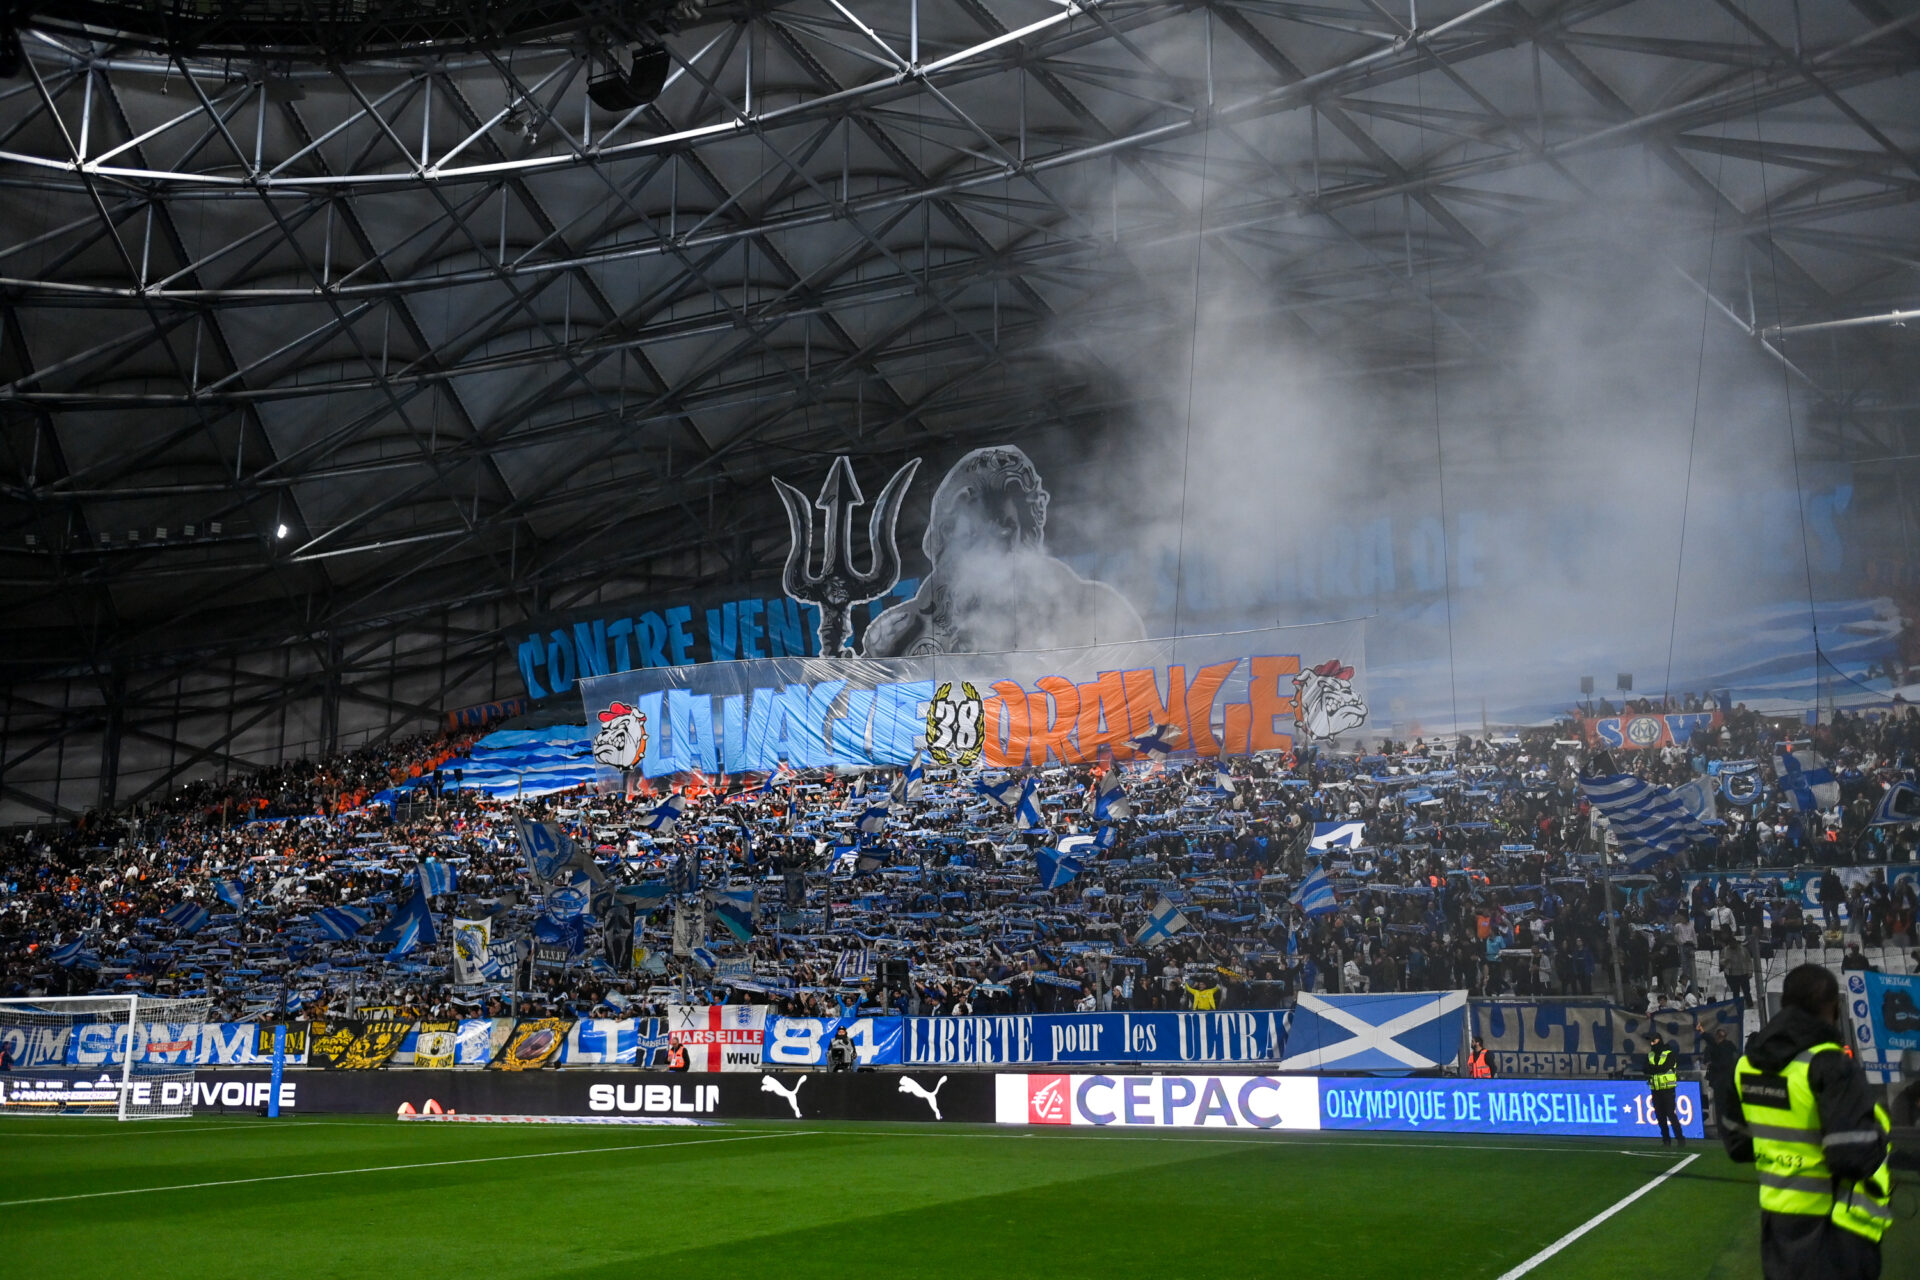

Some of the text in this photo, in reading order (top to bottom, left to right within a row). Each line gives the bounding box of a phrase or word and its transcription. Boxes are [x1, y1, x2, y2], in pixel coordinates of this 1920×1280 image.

[519, 605, 696, 699] CONTRE
[640, 689, 719, 779] LA
[934, 699, 981, 748] 38
[983, 655, 1300, 767] ORANGE
[671, 1031, 762, 1044] MARSEILLE
[727, 1052, 760, 1065] WHU
[908, 1016, 1033, 1063] LIBERTE
[1051, 1024, 1104, 1053] pour
[1123, 1014, 1157, 1053] les
[1076, 1075, 1282, 1129] CEPAC
[1326, 1088, 1693, 1126] OLYMPIQUE DE MARSEILLE 189
